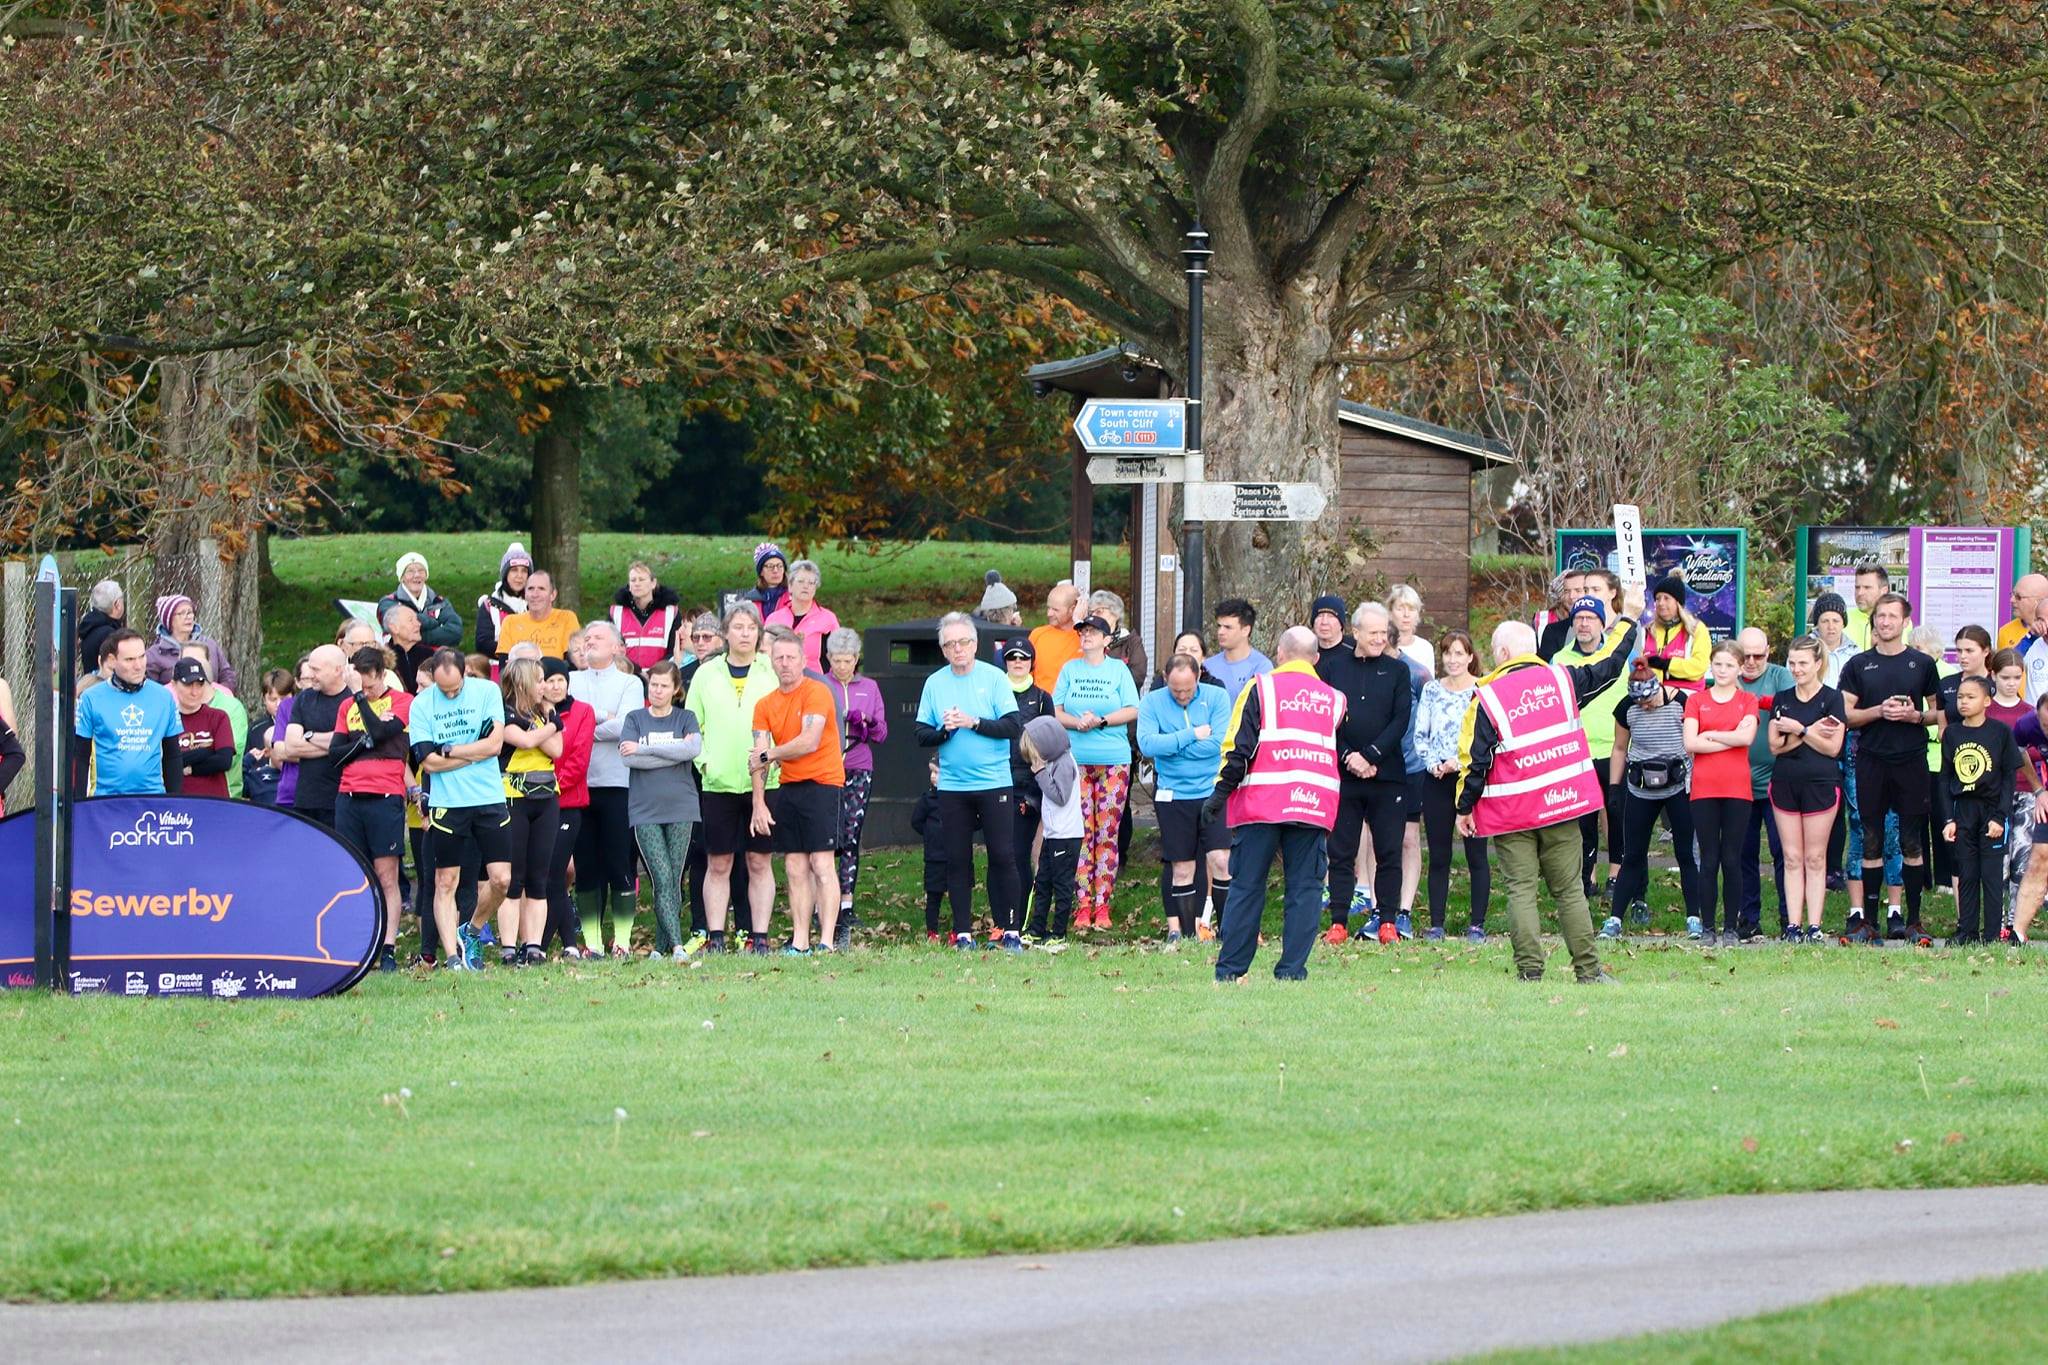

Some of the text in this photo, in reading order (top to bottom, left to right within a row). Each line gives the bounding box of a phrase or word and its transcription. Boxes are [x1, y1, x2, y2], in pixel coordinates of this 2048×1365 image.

[1100, 408, 1125, 417] Town
[1127, 408, 1158, 417] centre
[1100, 419, 1174, 429] South Cliff 4
[1623, 521, 1636, 576] QUIET
[1280, 692, 1331, 716] parkrun
[1508, 692, 1560, 722] parkrun
[434, 709, 475, 721] Yorkshire
[444, 719, 468, 729] Wolds
[116, 728, 153, 736] Yorkshire
[438, 728, 475, 740] Runners
[1515, 741, 1580, 769] VOLUNTEER
[1291, 786, 1320, 810] Vitality
[1544, 787, 1577, 806] Vitality
[159, 811, 193, 829] Vitality
[109, 817, 193, 849] parkrun
[70, 888, 233, 921] Sewerby
[271, 978, 297, 991] Persil
